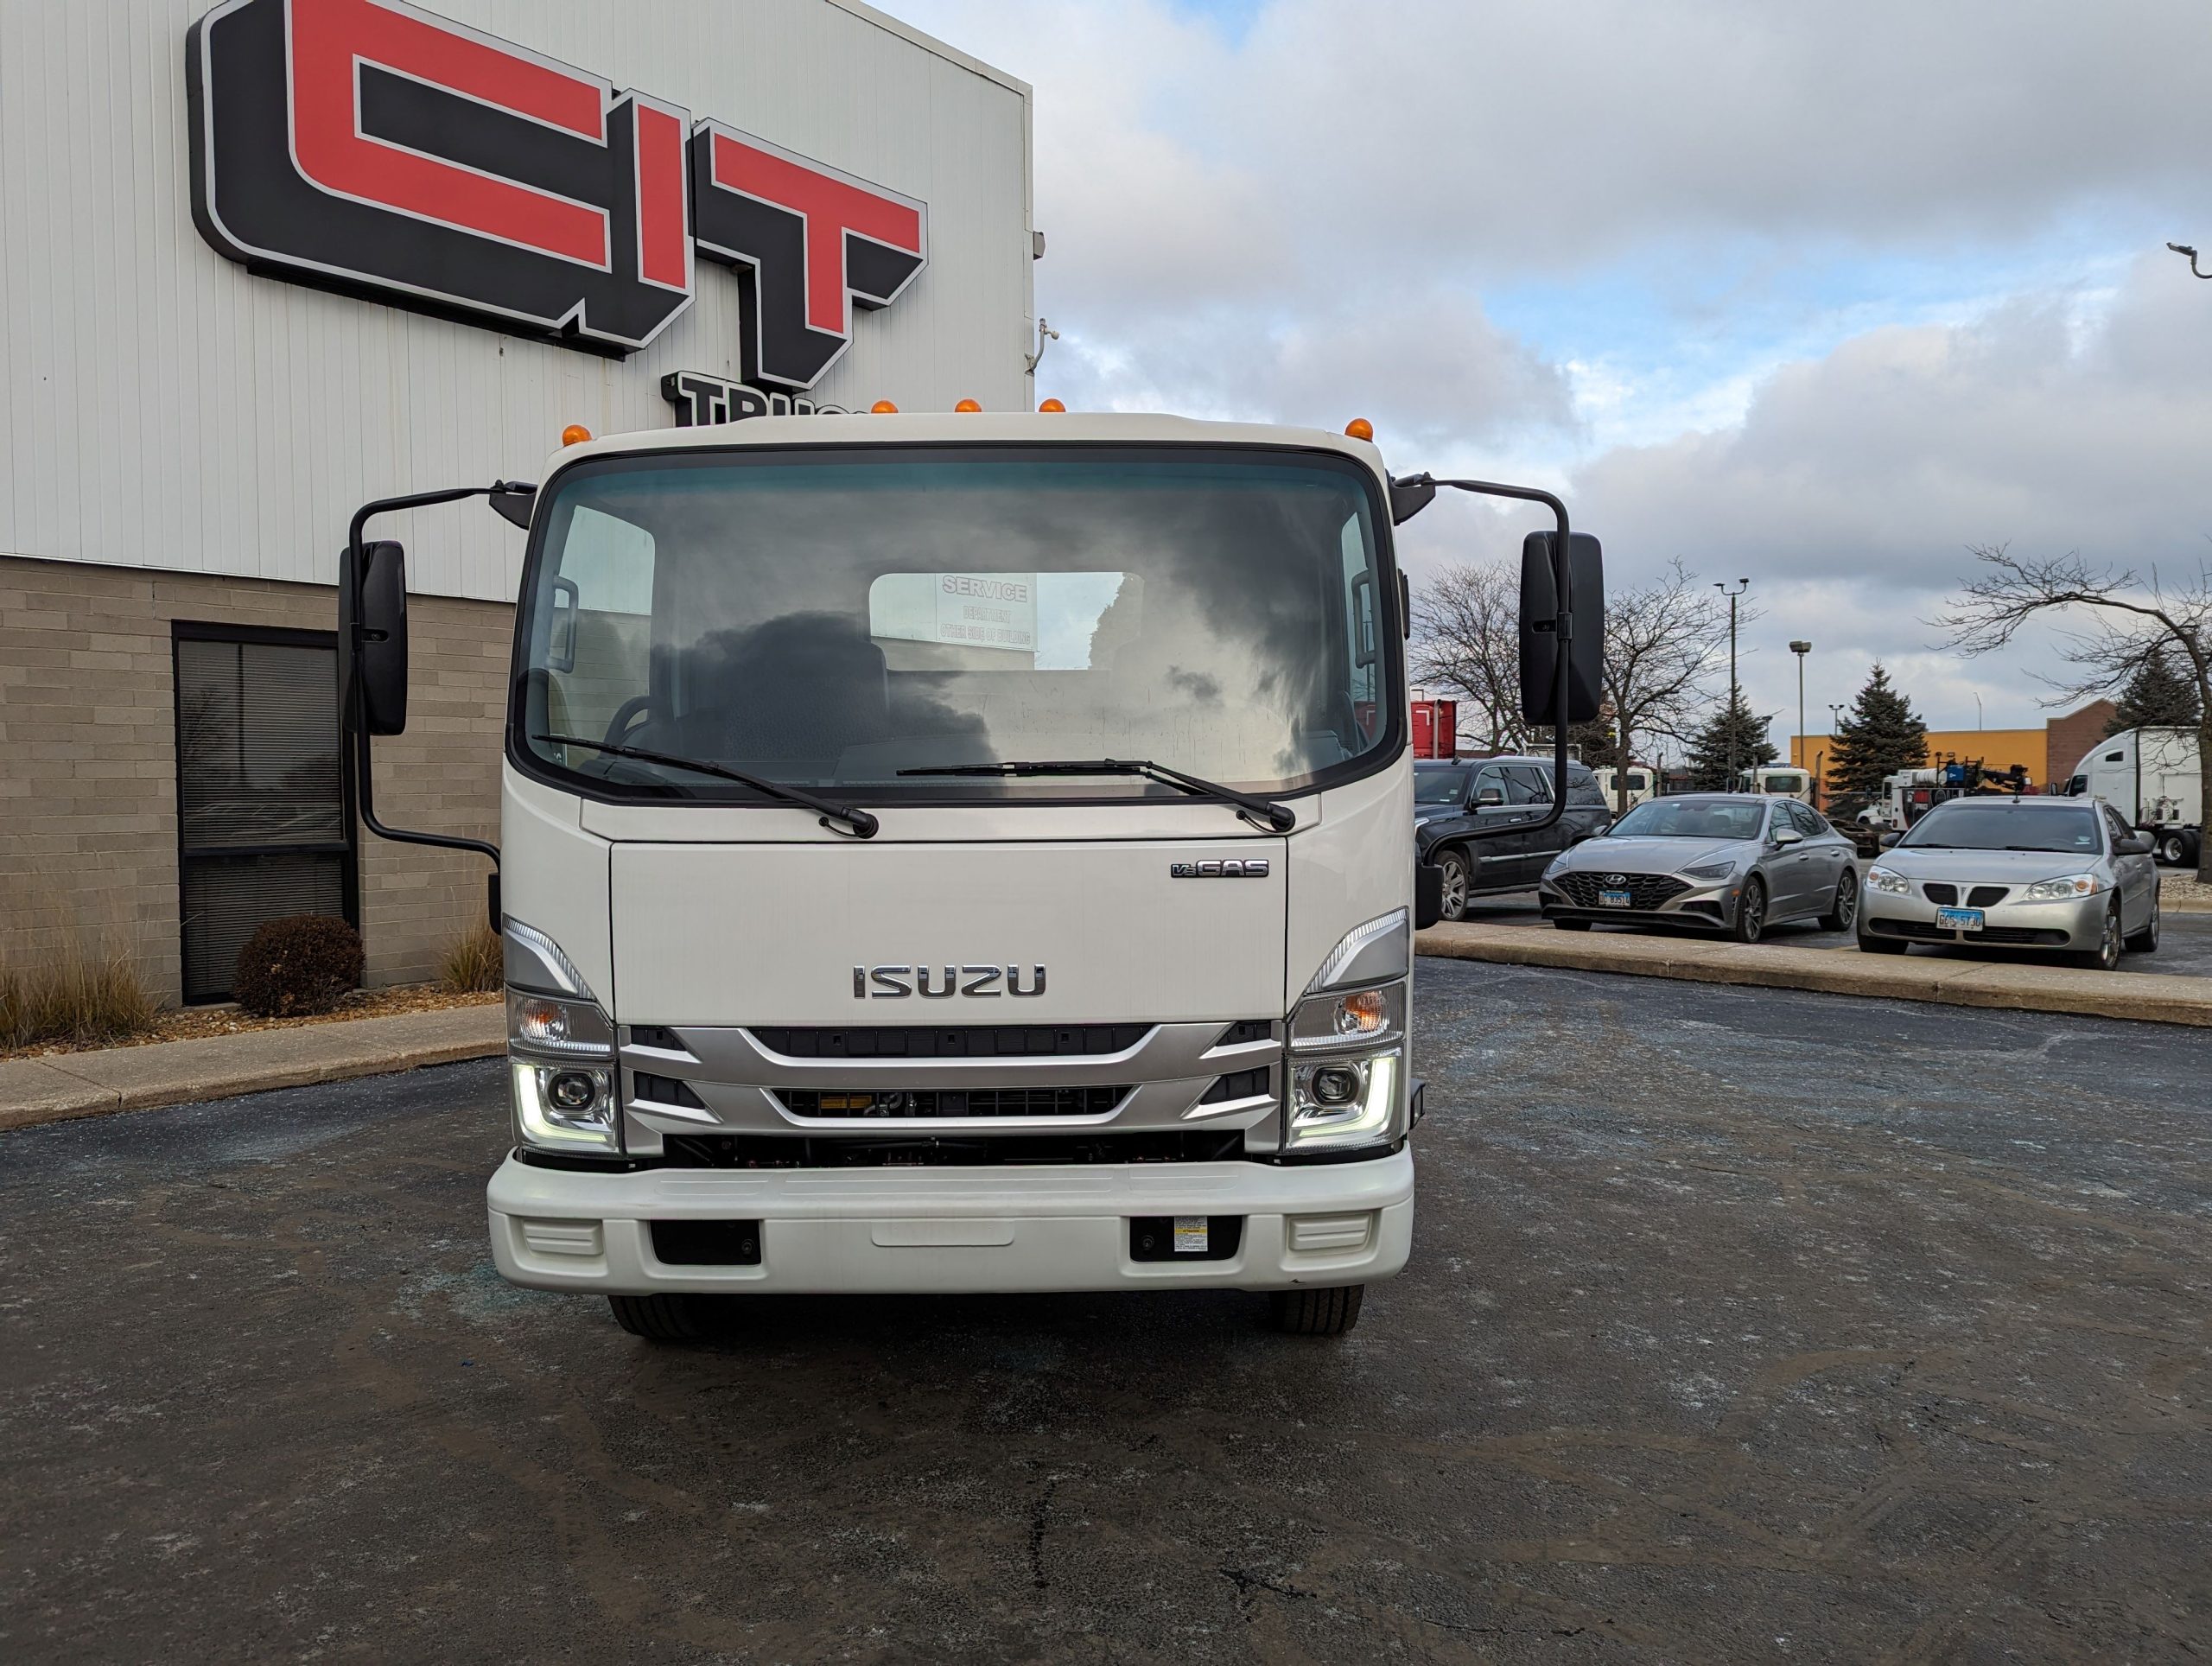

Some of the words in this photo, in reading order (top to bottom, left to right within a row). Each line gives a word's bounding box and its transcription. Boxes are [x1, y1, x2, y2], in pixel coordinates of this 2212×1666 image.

[199, 0, 929, 385] CIT
[943, 575, 1027, 602] SERVICE
[963, 605, 1011, 623] DEPARTMENT
[940, 623, 967, 639] OTHER
[968, 626, 985, 641] SIDE
[987, 627, 996, 642] OF
[997, 629, 1031, 645] BUILDING
[854, 964, 1046, 999] ISUZU
